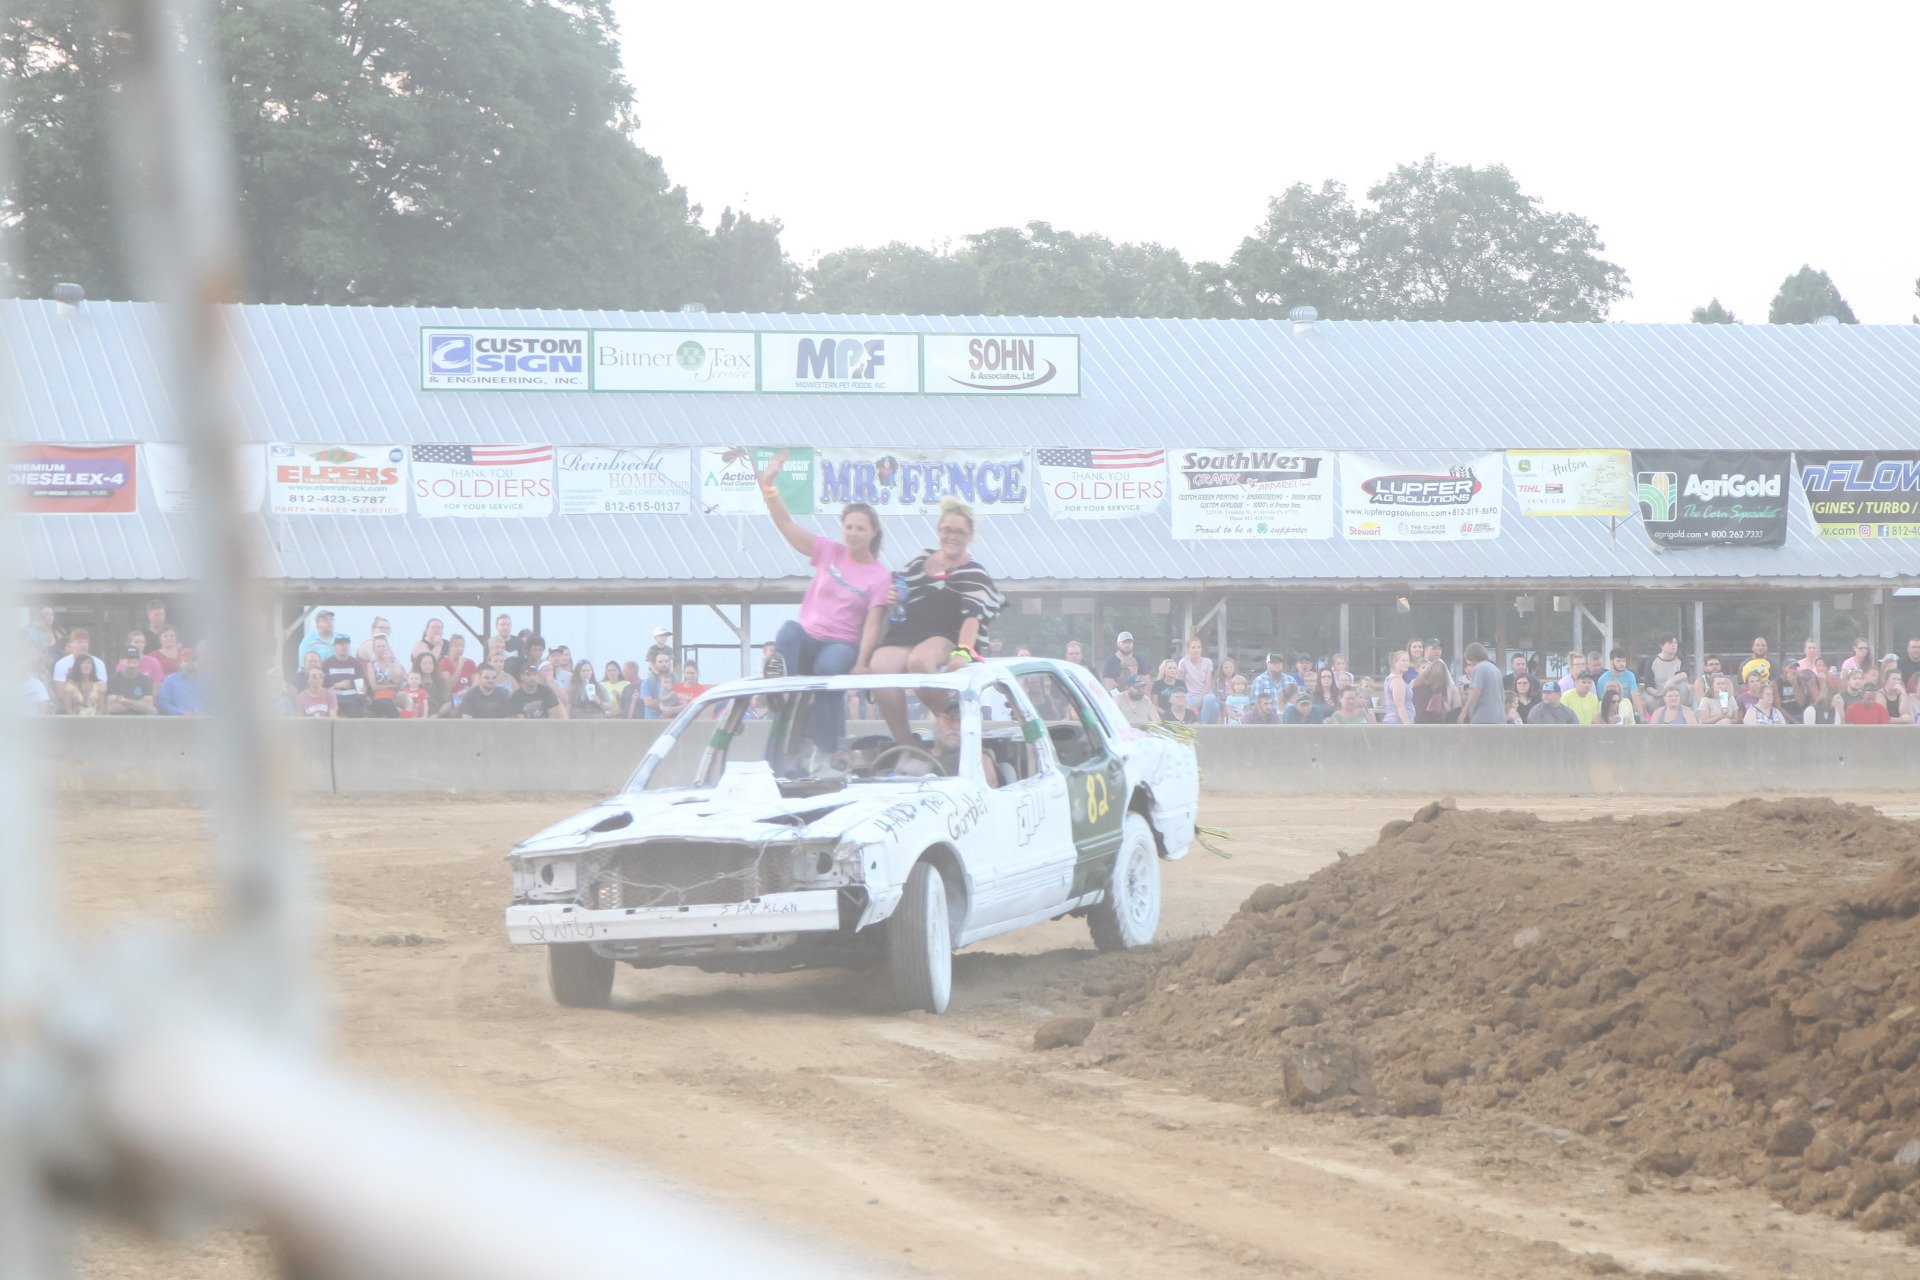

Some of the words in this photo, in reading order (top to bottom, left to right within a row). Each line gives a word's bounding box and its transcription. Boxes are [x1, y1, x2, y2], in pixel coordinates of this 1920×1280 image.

[475, 338, 582, 354] CUSTOM
[598, 346, 673, 367] Bittner
[708, 347, 752, 367] Tax
[796, 337, 885, 380] MPF
[968, 338, 1035, 371] SOHN
[476, 354, 582, 373] SIGN
[447, 376, 548, 385] ENGINEERING,
[555, 377, 583, 385] INC.
[970, 372, 976, 380] &
[978, 372, 1020, 380] Associates,
[1022, 372, 1035, 380] Ltd
[7, 472, 125, 486] DIESELEX-4
[276, 465, 399, 485] ELPERS
[450, 468, 486, 478] THANK
[490, 468, 513, 478] YOU
[722, 472, 757, 481] Action
[1071, 471, 1106, 481] THANK
[1108, 471, 1130, 481] YOU
[416, 479, 551, 498] SOLDIERS
[819, 459, 892, 505] MR.
[898, 459, 1027, 505] FENCE
[1375, 480, 1474, 496] LUPFER
[1683, 473, 1782, 501] AgriGold
[1042, 480, 1164, 500] OLDIERS
[288, 494, 387, 504] 812-423-5787
[1372, 494, 1395, 502] AG
[1396, 493, 1471, 504] SOLUTIONS
[604, 501, 681, 512] 812-615-0137
[1683, 504, 1701, 519] The
[1703, 504, 1728, 519] Corn
[1866, 501, 1911, 514] TURBO
[1194, 524, 1221, 535] Proud
[1223, 526, 1233, 534] to
[1234, 525, 1245, 534] be
[1270, 526, 1308, 535] supporter
[1349, 526, 1382, 536] Stewart
[1654, 530, 1702, 540] agrigold.com
[1086, 772, 1110, 824] 82
